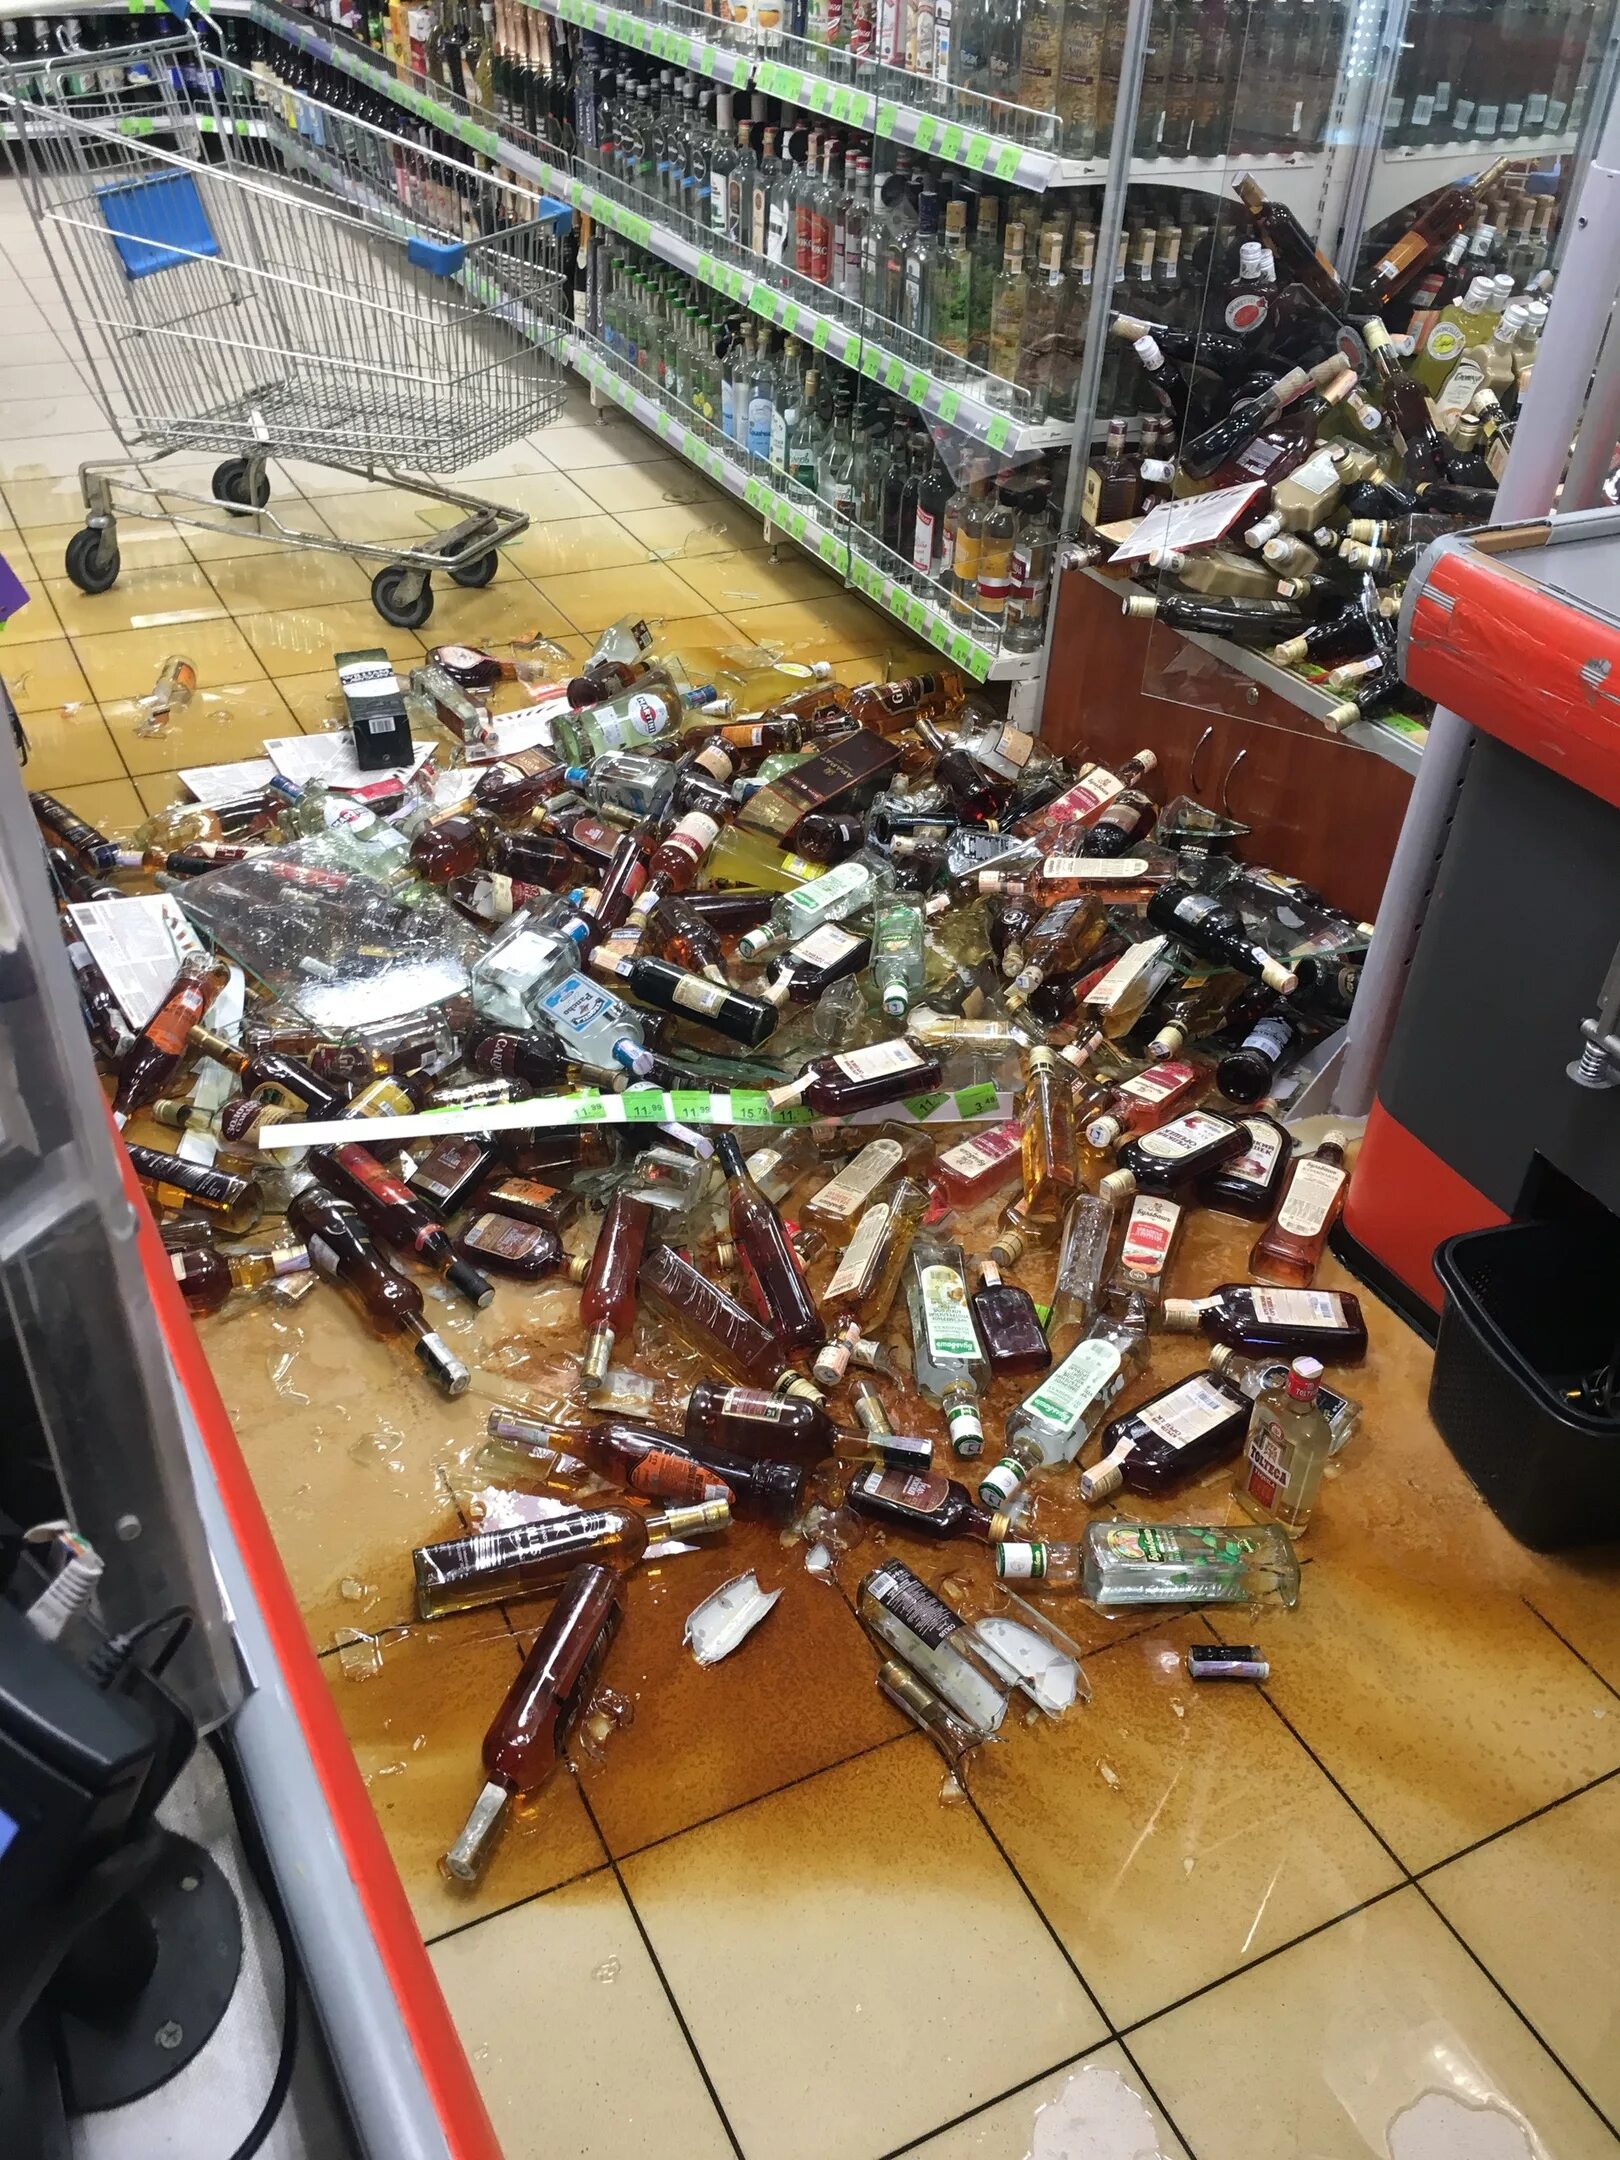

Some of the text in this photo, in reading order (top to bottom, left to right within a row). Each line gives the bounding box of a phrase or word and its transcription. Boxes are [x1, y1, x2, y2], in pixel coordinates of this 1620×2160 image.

[637, 696, 656, 734] MARTINI
[563, 992, 594, 1016] Pancho
[1137, 1208, 1172, 1223] Бульбашъ
[936, 1340, 973, 1351] Бульбашъ
[1034, 1398, 1071, 1423] Бульбашъ
[1250, 1445, 1287, 1486] TOLTECA
